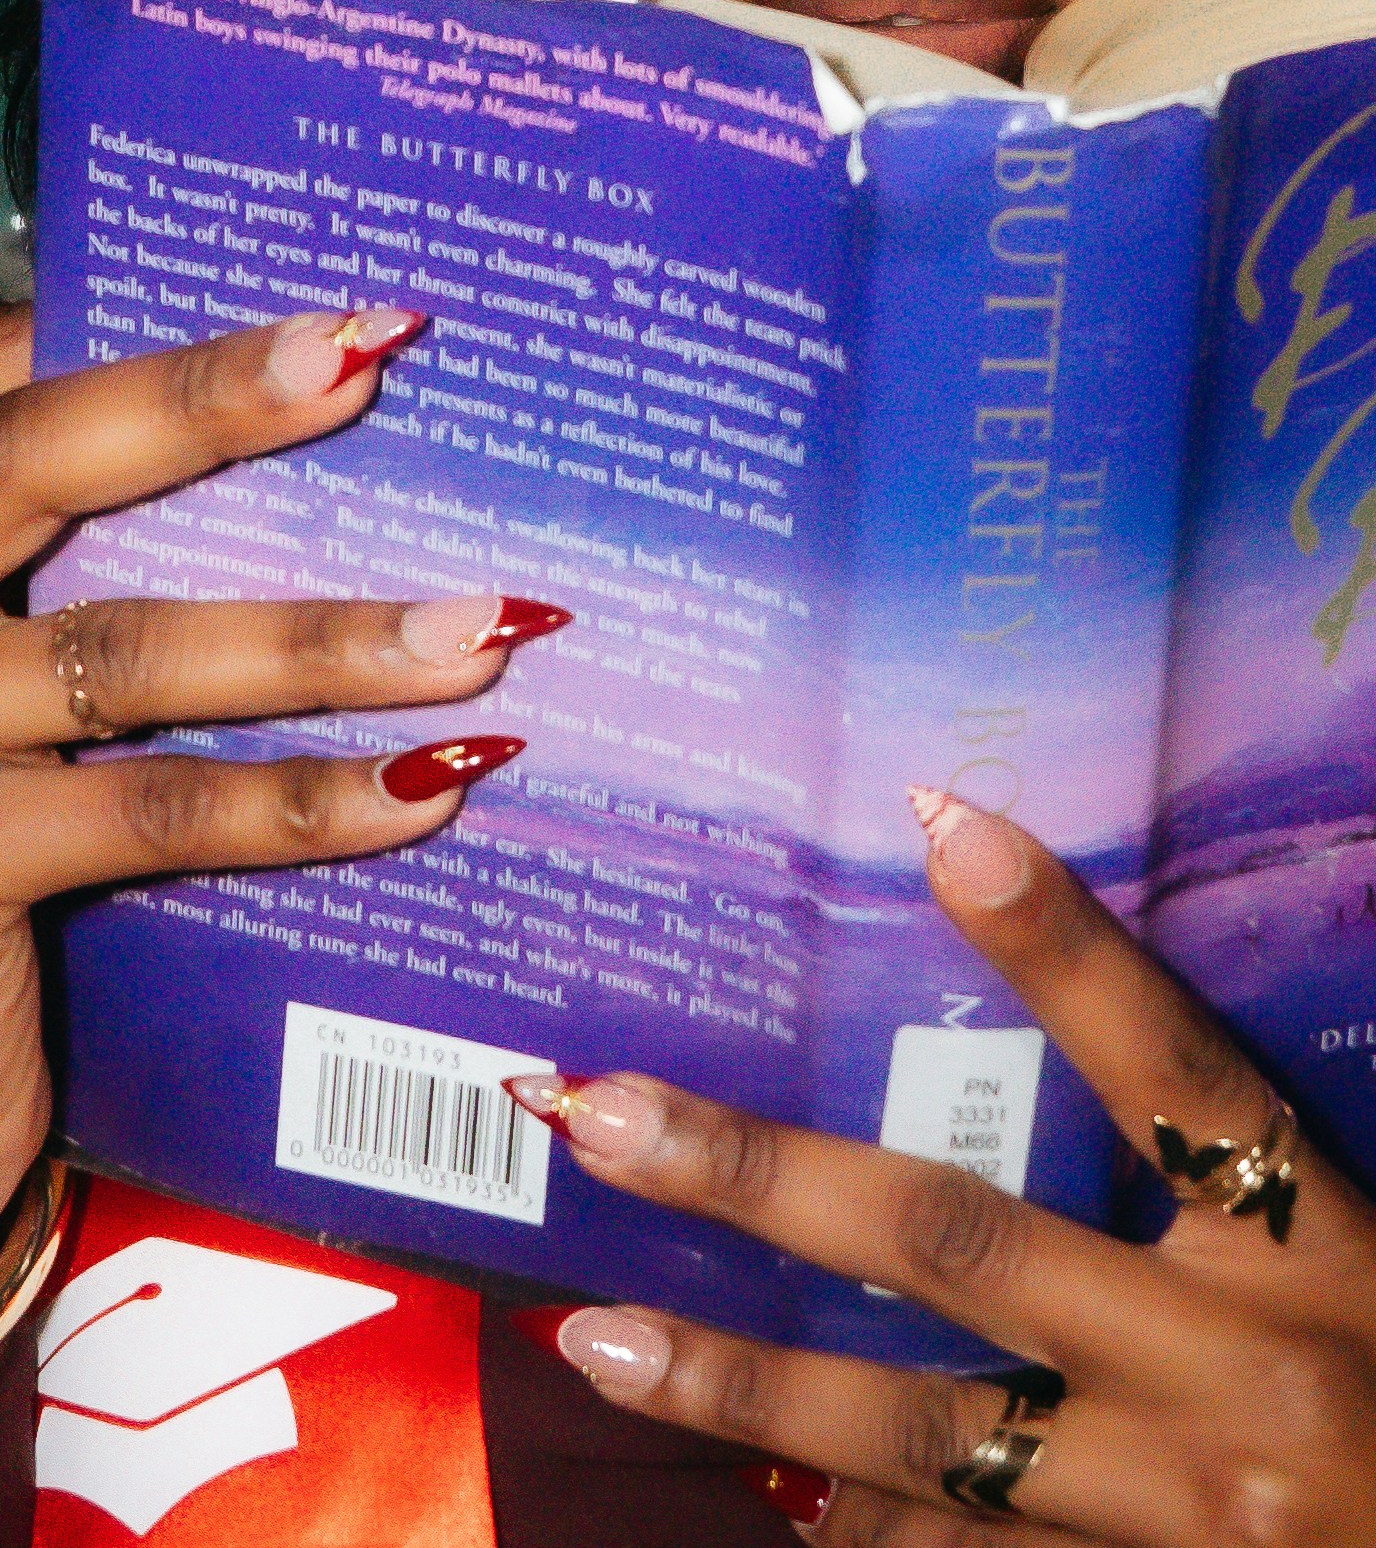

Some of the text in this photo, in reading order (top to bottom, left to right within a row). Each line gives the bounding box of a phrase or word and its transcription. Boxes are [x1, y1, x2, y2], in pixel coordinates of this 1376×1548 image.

[293, 115, 655, 216] THE BUTTERFLY BOX
[89, 122, 826, 324] Federica unwrapped the paper to discover a roughly carved wooden
[960, 144, 1077, 666] BUTTERFLY
[1052, 455, 1108, 568] THE
[317, 1023, 461, 1070] CN 103193
[964, 1077, 1002, 1096] PN
[949, 1106, 1007, 1124] 3331
